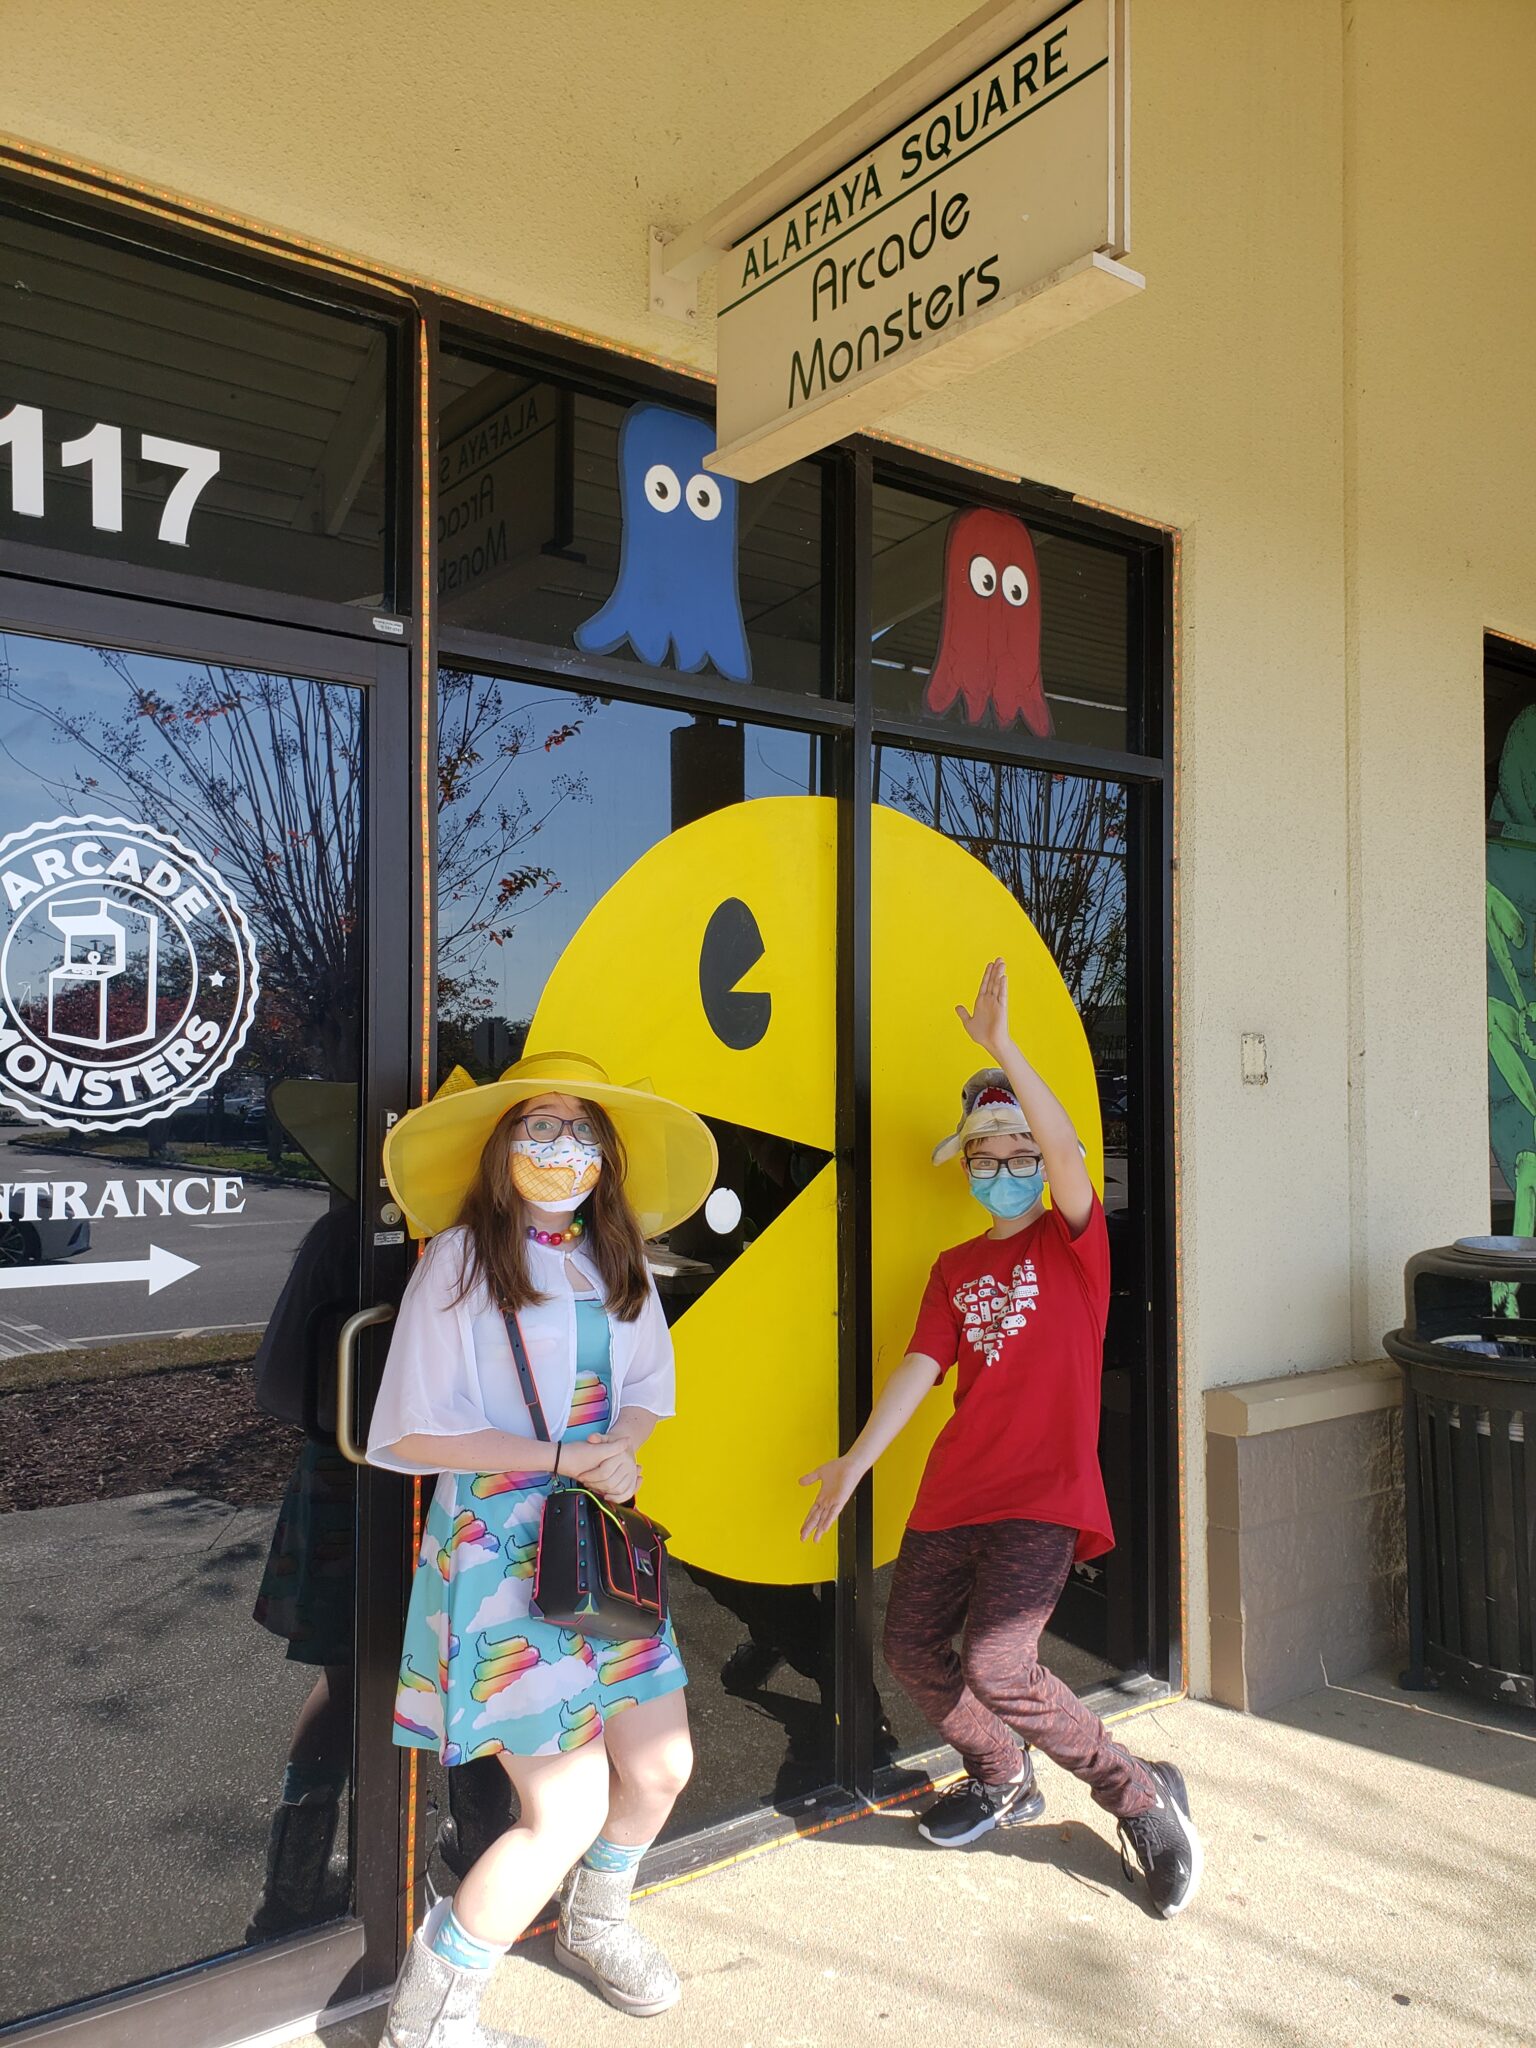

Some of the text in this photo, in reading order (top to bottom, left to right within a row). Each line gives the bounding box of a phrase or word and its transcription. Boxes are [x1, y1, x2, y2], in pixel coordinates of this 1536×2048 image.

[741, 25, 1069, 289] ALAFAYA SQUARE
[812, 189, 970, 322] Arcade
[788, 254, 1000, 409] Monsters
[0, 404, 220, 546] 117
[1, 841, 211, 923] ARCADE
